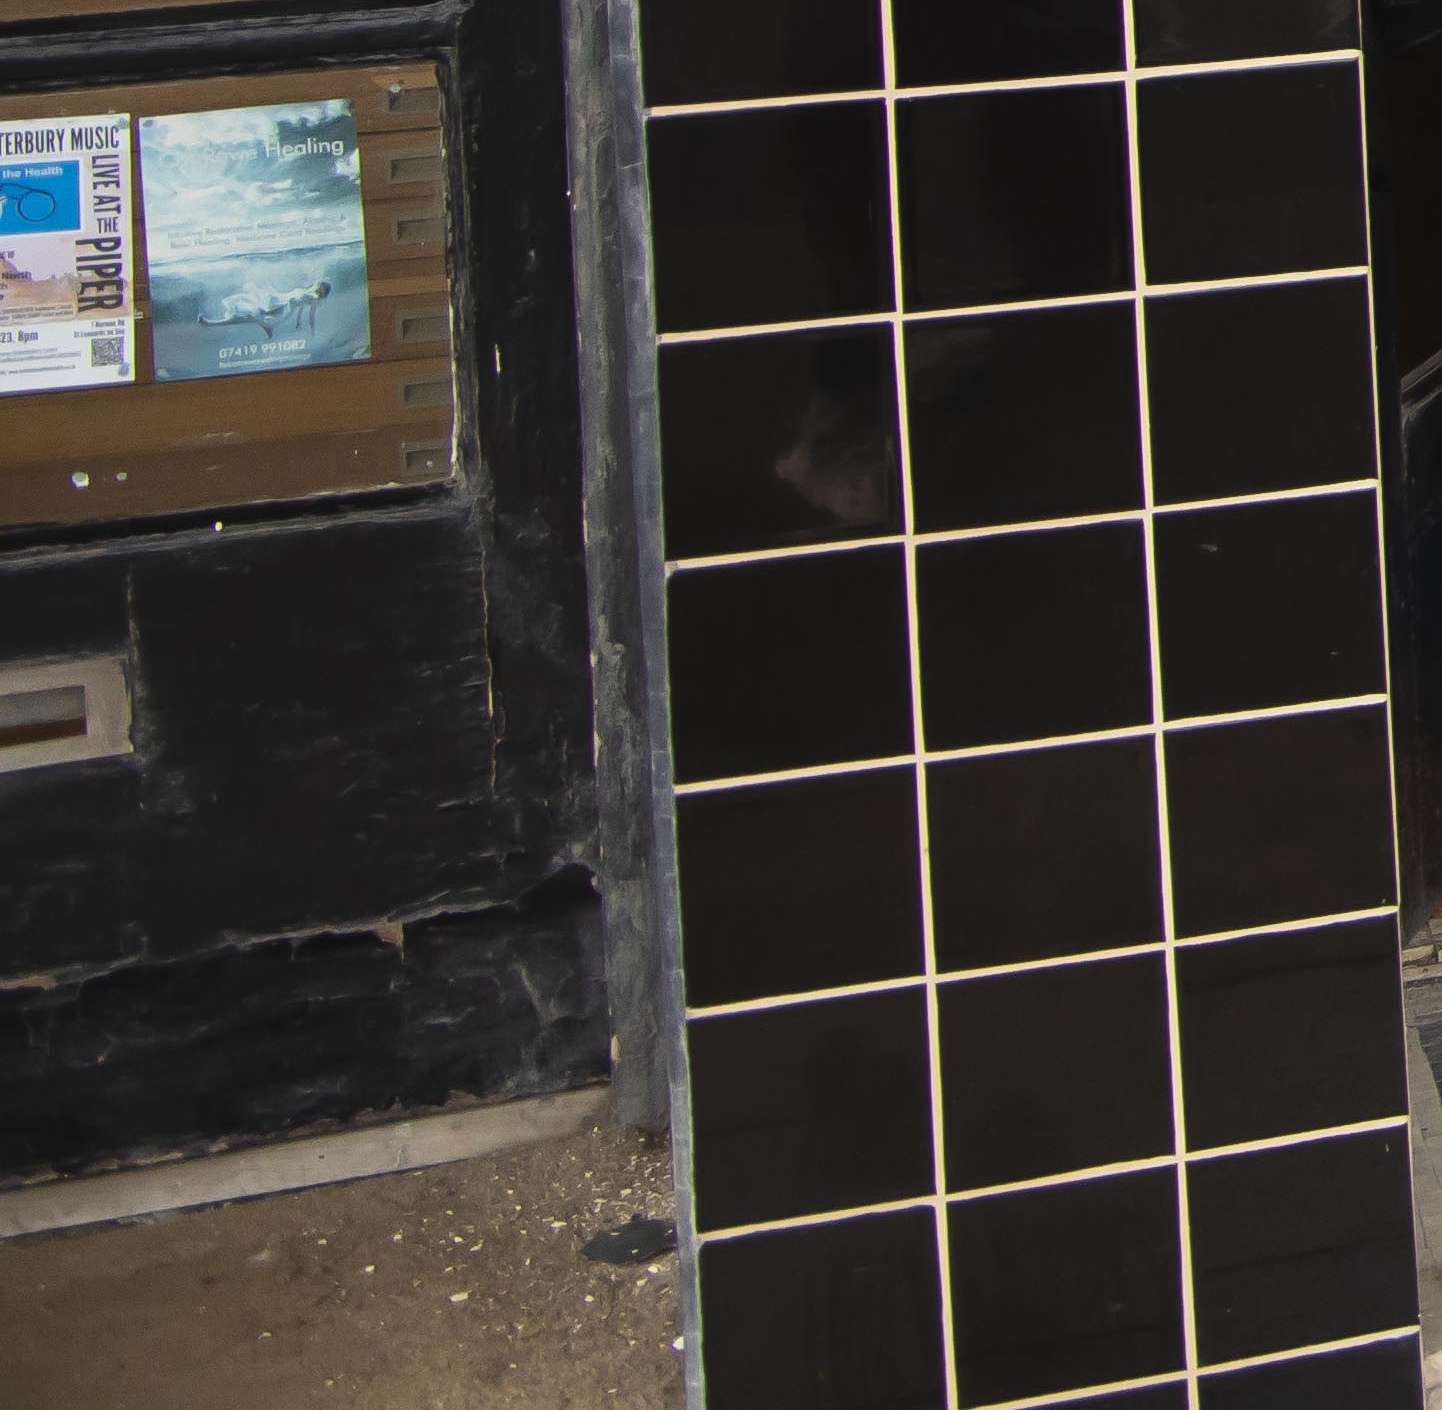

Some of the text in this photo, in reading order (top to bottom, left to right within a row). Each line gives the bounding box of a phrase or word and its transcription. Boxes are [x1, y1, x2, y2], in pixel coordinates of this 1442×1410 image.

[71, 126, 119, 151] MUSIC
[264, 138, 344, 159] Healing
[3, 166, 63, 178] the Health
[75, 154, 124, 313] LIVE AT THE PIPER
[18, 330, 39, 345] 8pm
[219, 344, 257, 359] 07419
